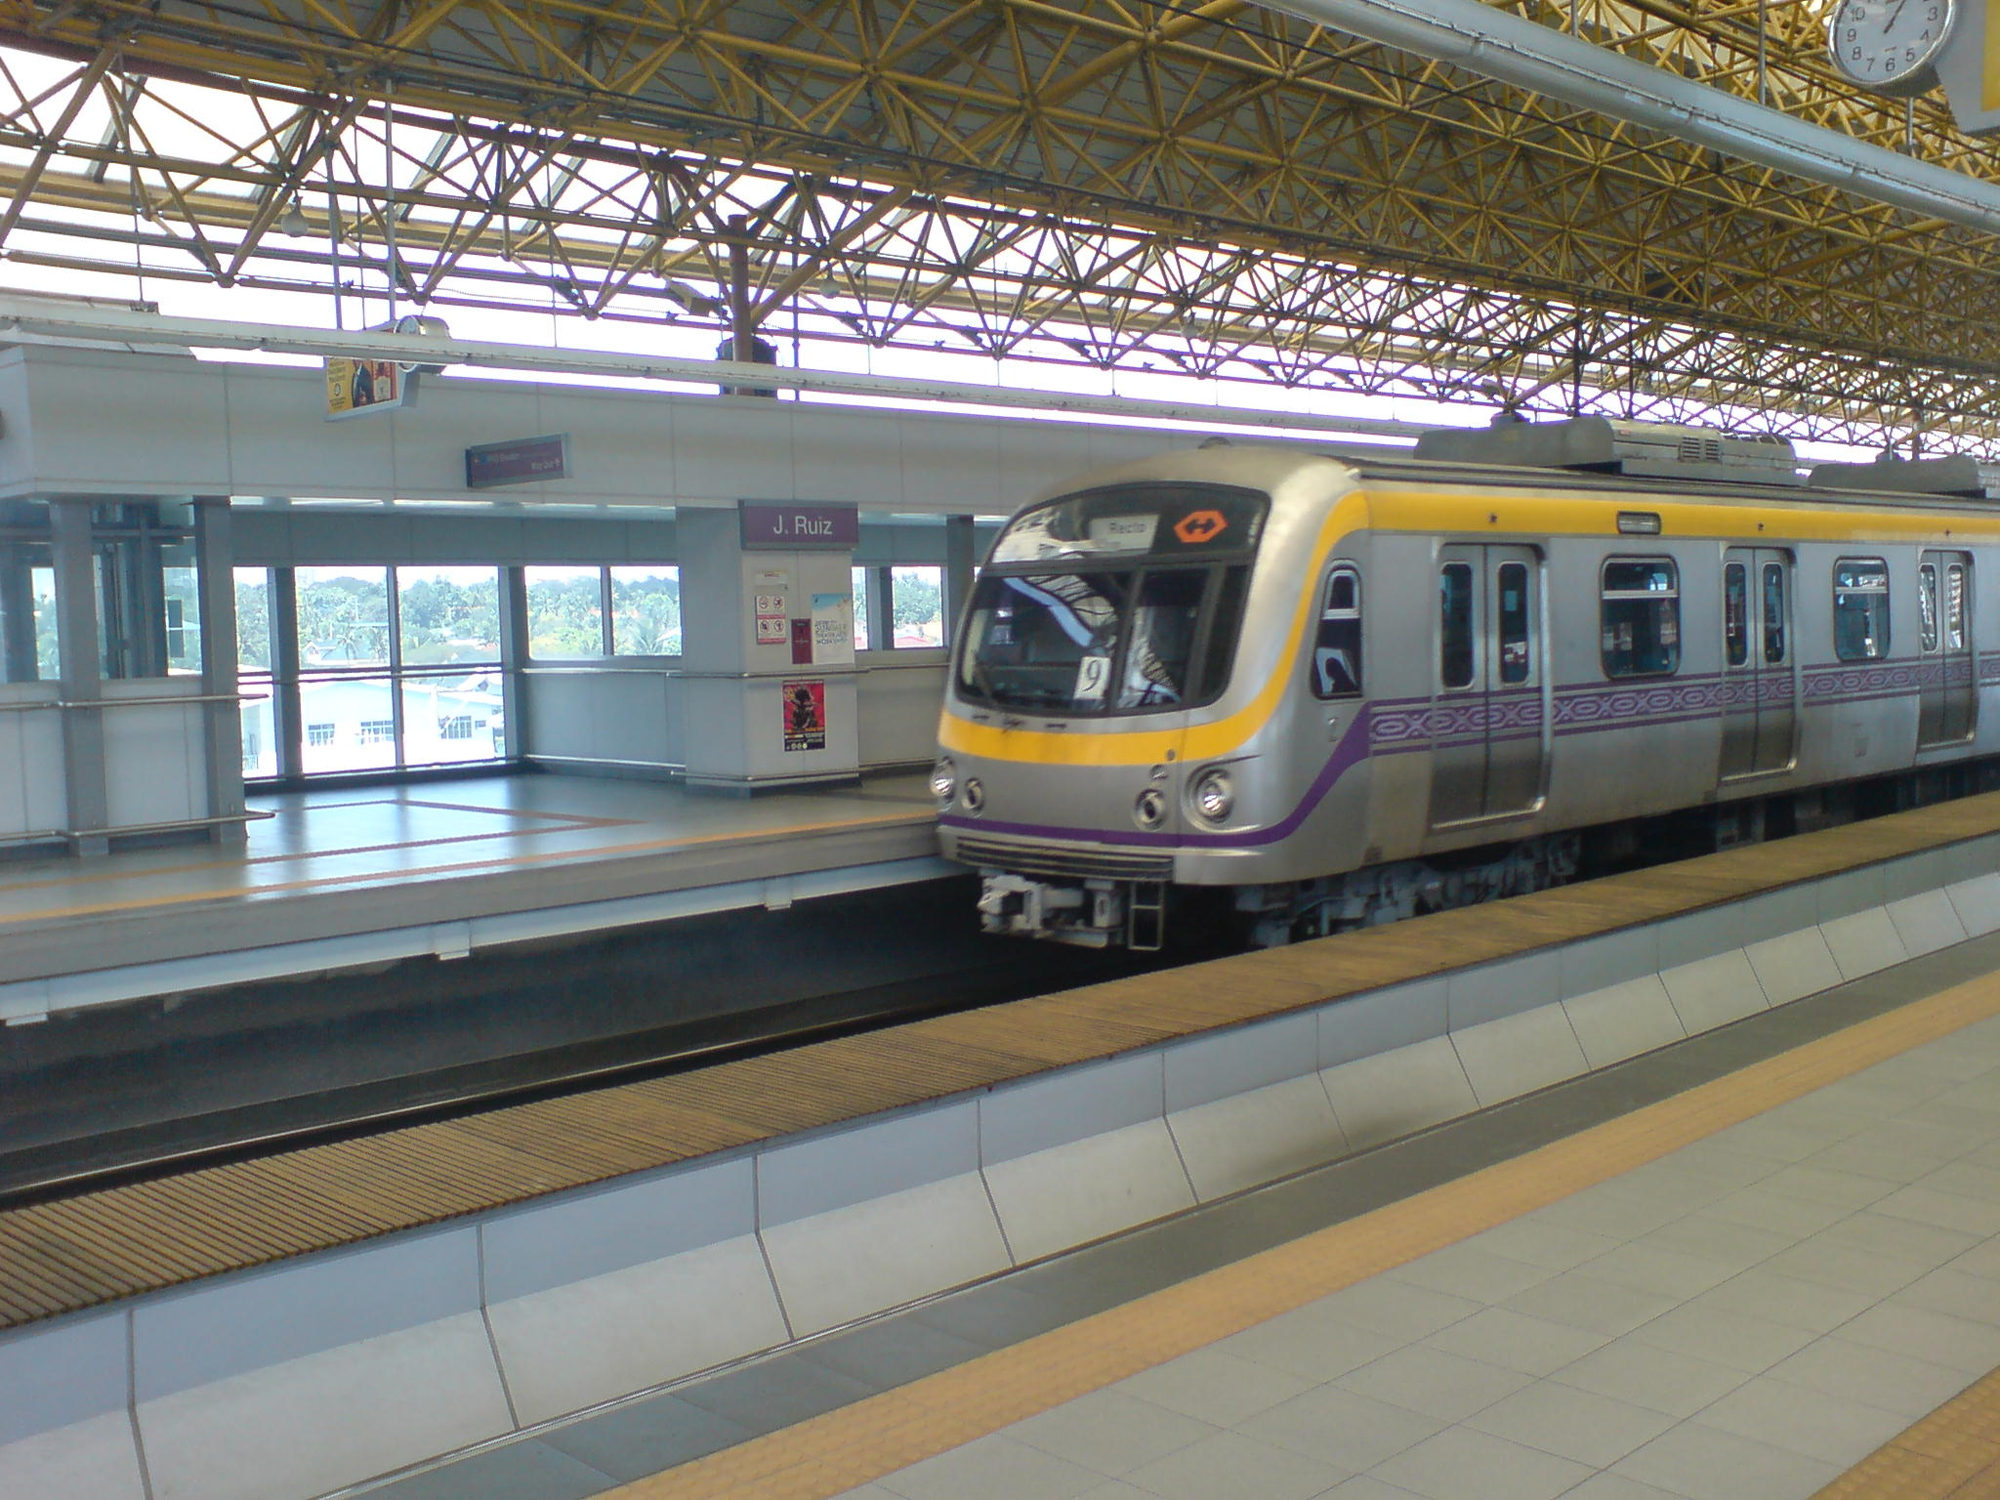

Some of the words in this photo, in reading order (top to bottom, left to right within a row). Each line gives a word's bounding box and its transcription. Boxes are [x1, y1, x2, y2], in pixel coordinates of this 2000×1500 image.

[1850, 7, 1866, 21] 10
[1927, 6, 1938, 21] 3
[1847, 28, 1857, 42] 9
[1920, 28, 1930, 42] 4
[1852, 46, 1862, 61] 8
[1905, 47, 1915, 62] 5
[1866, 57, 1876, 72] 7
[1885, 57, 1896, 72] 6
[773, 515, 789, 535] J.
[795, 515, 833, 535] Ruiz
[1081, 659, 1102, 692] 9
